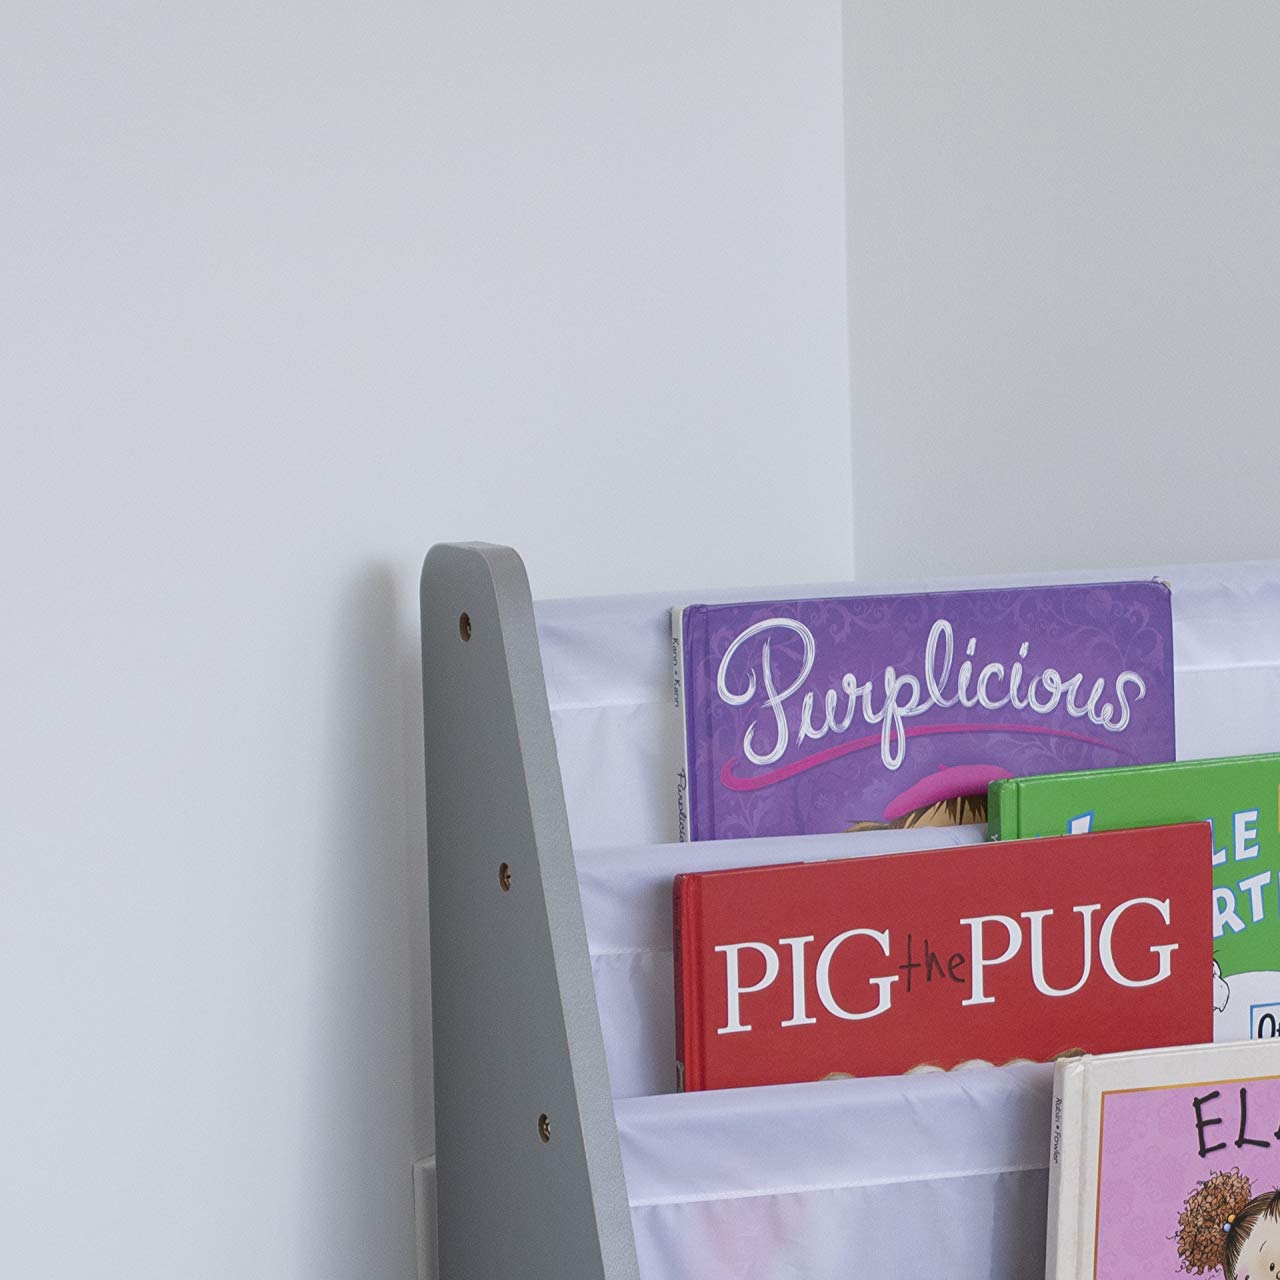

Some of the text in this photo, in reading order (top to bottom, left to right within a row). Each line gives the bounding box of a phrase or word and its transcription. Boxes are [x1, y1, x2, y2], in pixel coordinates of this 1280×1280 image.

[717, 617, 1146, 770] Purplicious
[677, 767, 687, 843] Purplicio
[714, 928, 899, 1035] PIG
[899, 933, 966, 993] the
[960, 897, 1179, 1006] PUG
